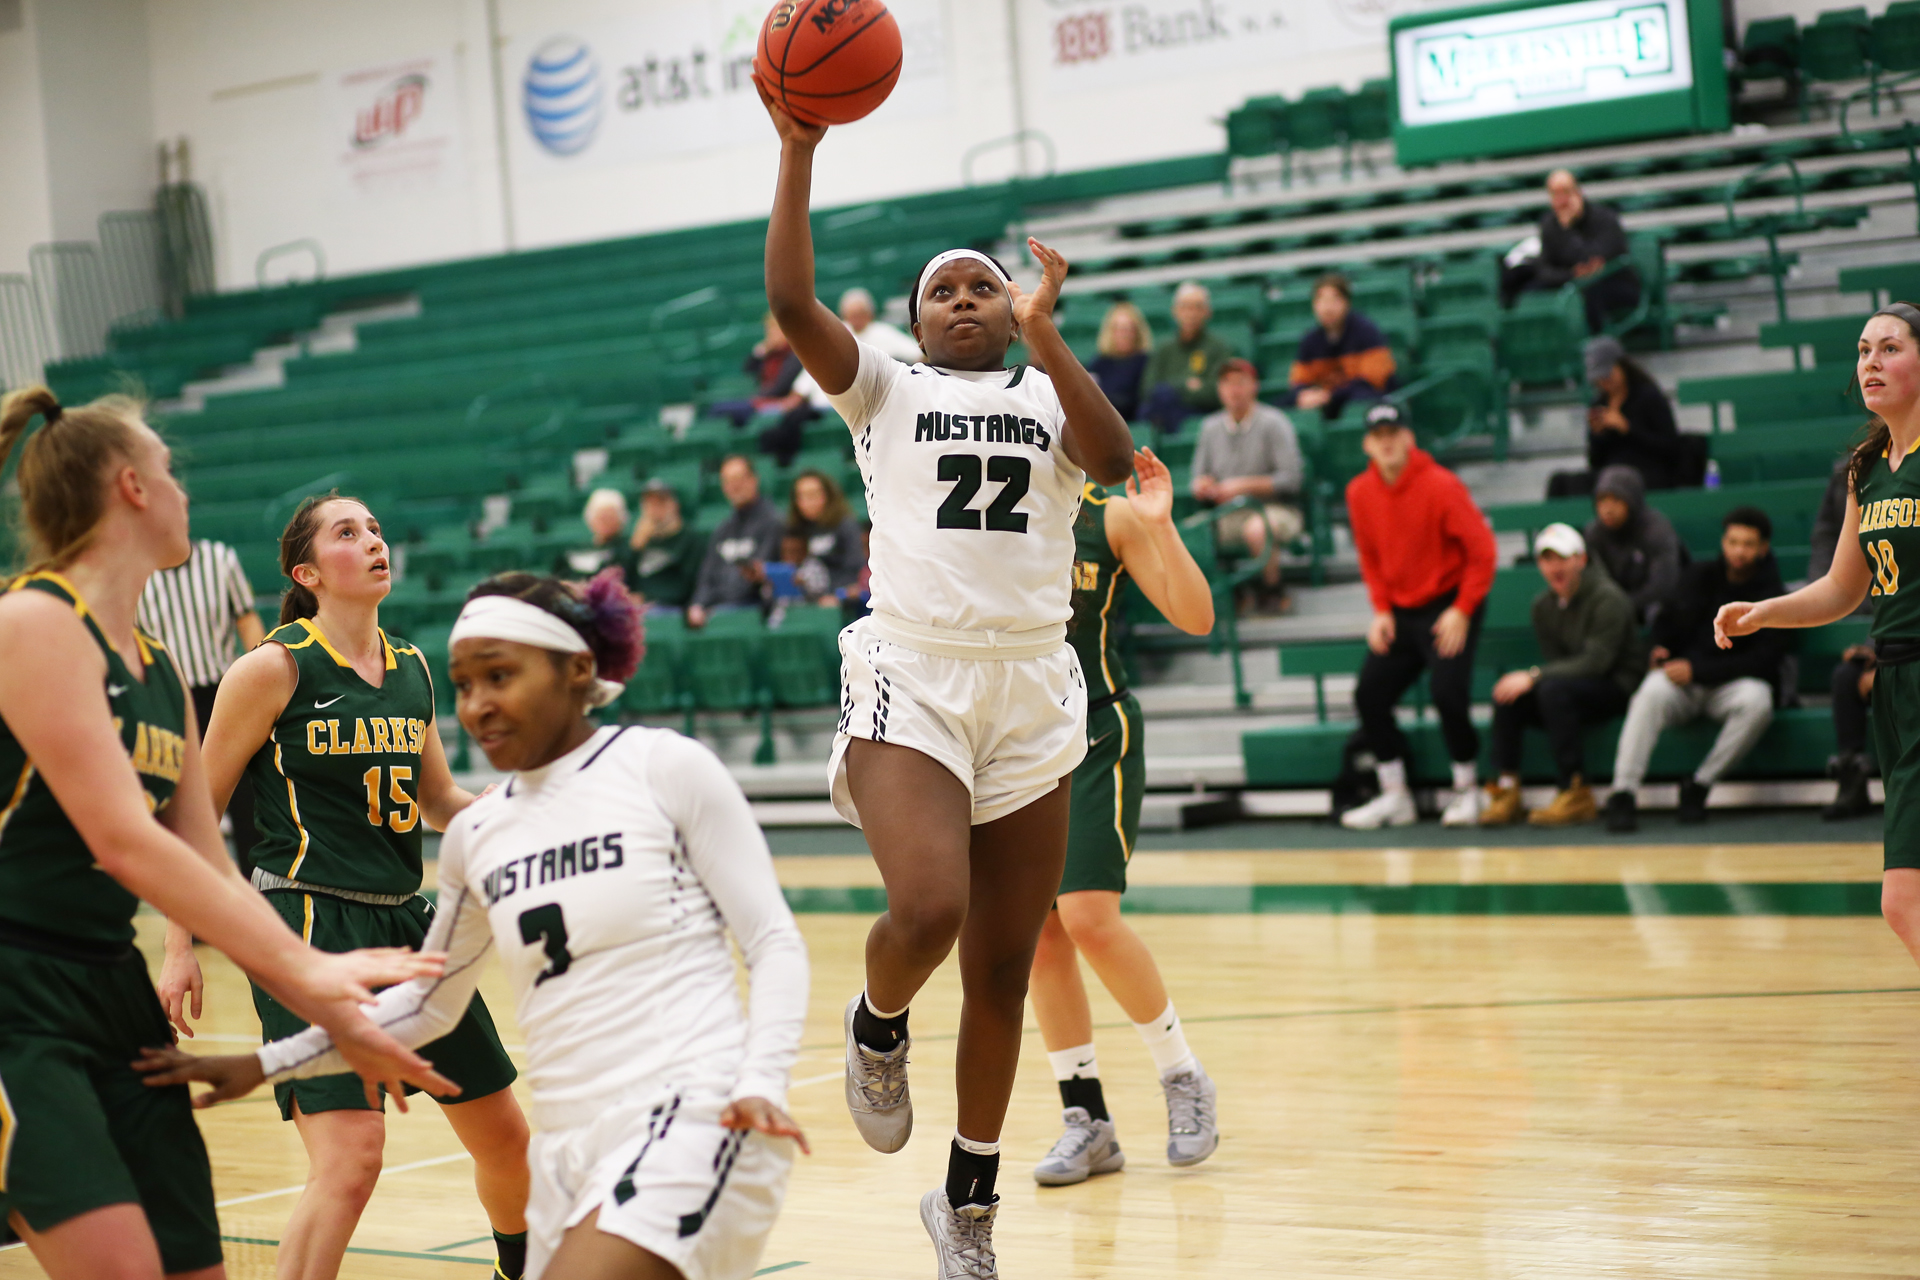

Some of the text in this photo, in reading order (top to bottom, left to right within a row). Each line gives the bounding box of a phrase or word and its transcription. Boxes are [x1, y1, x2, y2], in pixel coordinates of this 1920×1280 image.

[1121, 0, 1228, 54] Bank
[914, 411, 1051, 452] MUSTANGS
[936, 454, 1031, 534] 22
[1867, 539, 1899, 597] 10
[306, 717, 427, 756] CLARKSO
[363, 766, 419, 833] 15
[518, 902, 574, 988] 3
